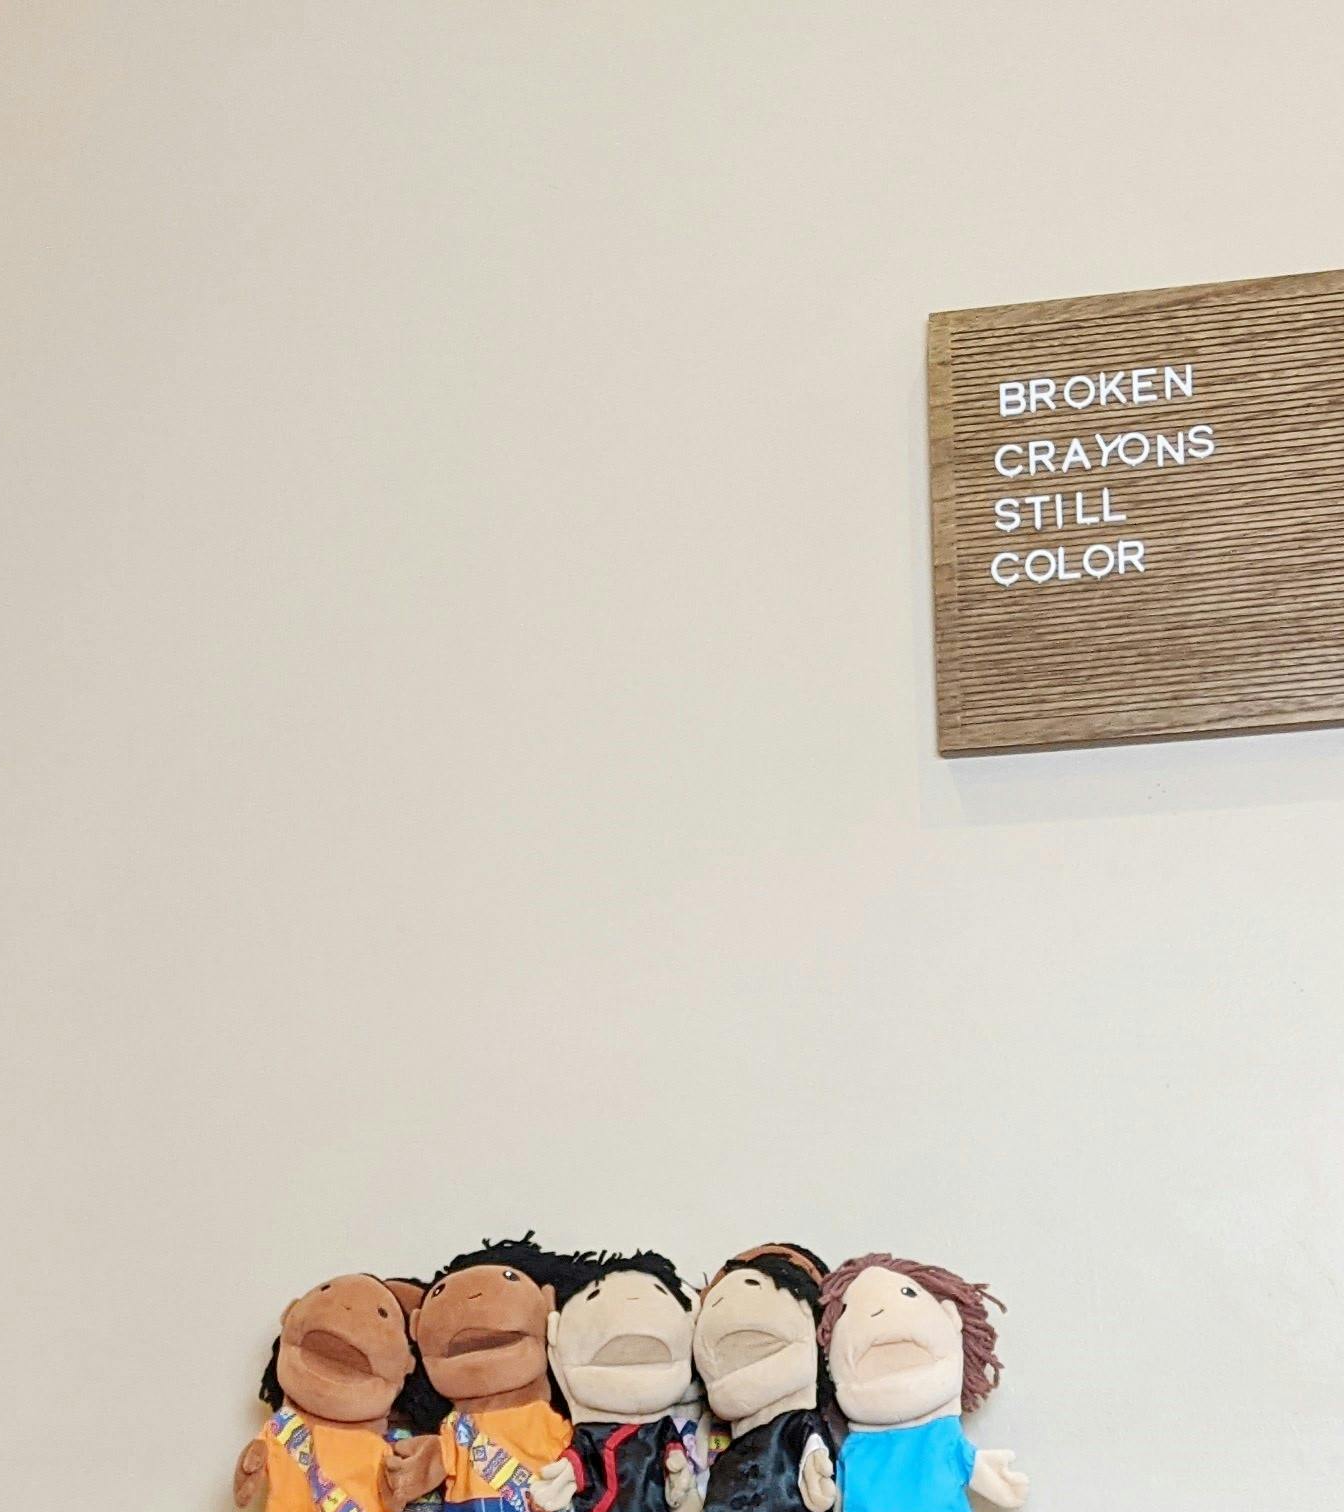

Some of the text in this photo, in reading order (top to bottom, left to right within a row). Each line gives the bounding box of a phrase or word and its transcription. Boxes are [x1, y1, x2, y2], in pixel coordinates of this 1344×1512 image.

[999, 364, 1193, 417] BROKEN
[994, 424, 1215, 478] CRAYONS
[994, 487, 1127, 532] STILL
[990, 539, 1145, 587] COLOR
